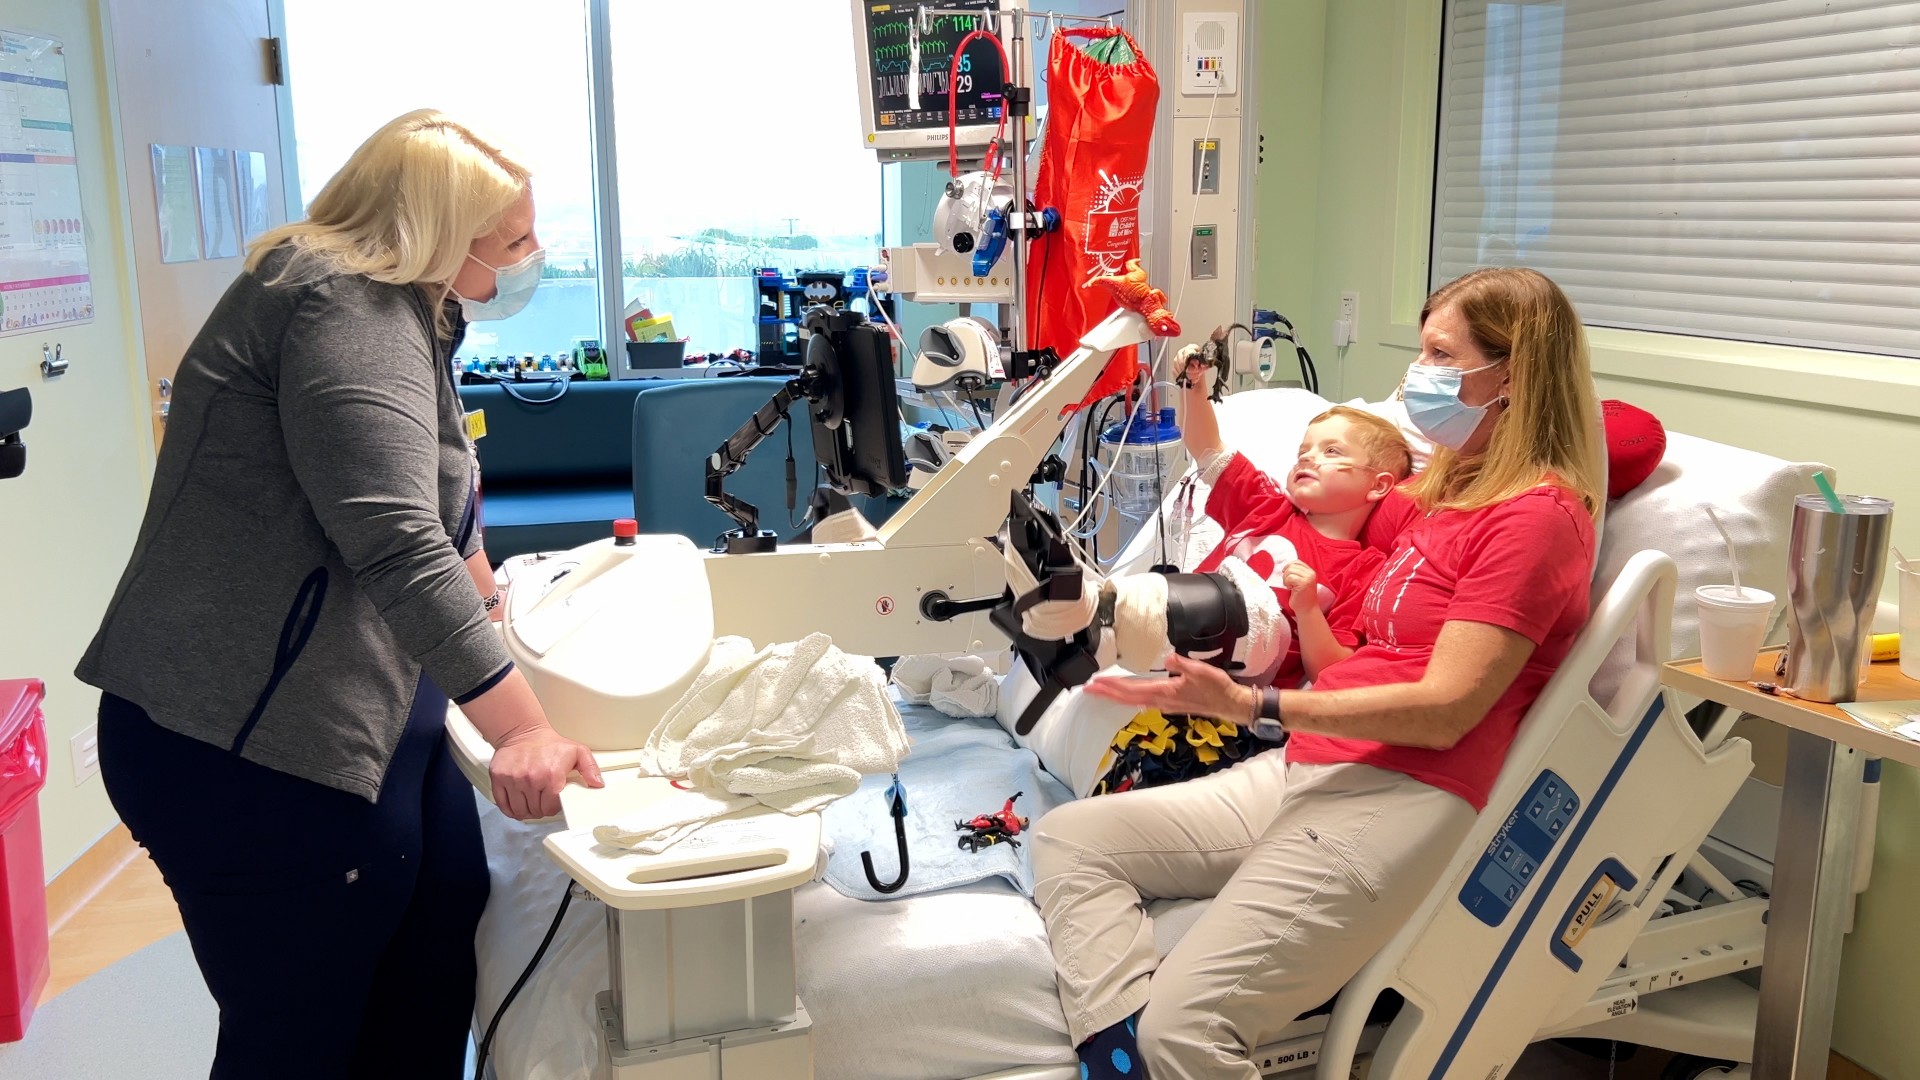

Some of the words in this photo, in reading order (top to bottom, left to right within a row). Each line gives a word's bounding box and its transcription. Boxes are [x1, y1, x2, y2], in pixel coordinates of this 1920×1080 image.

[953, 15, 972, 31] 114
[957, 74, 973, 93] 29
[1487, 809, 1519, 857] stryker
[1575, 892, 1602, 925] PULL
[1607, 1003, 1631, 1013] ELEVATION
[1278, 1055, 1295, 1064] 500
[1297, 1051, 1309, 1060] LB
